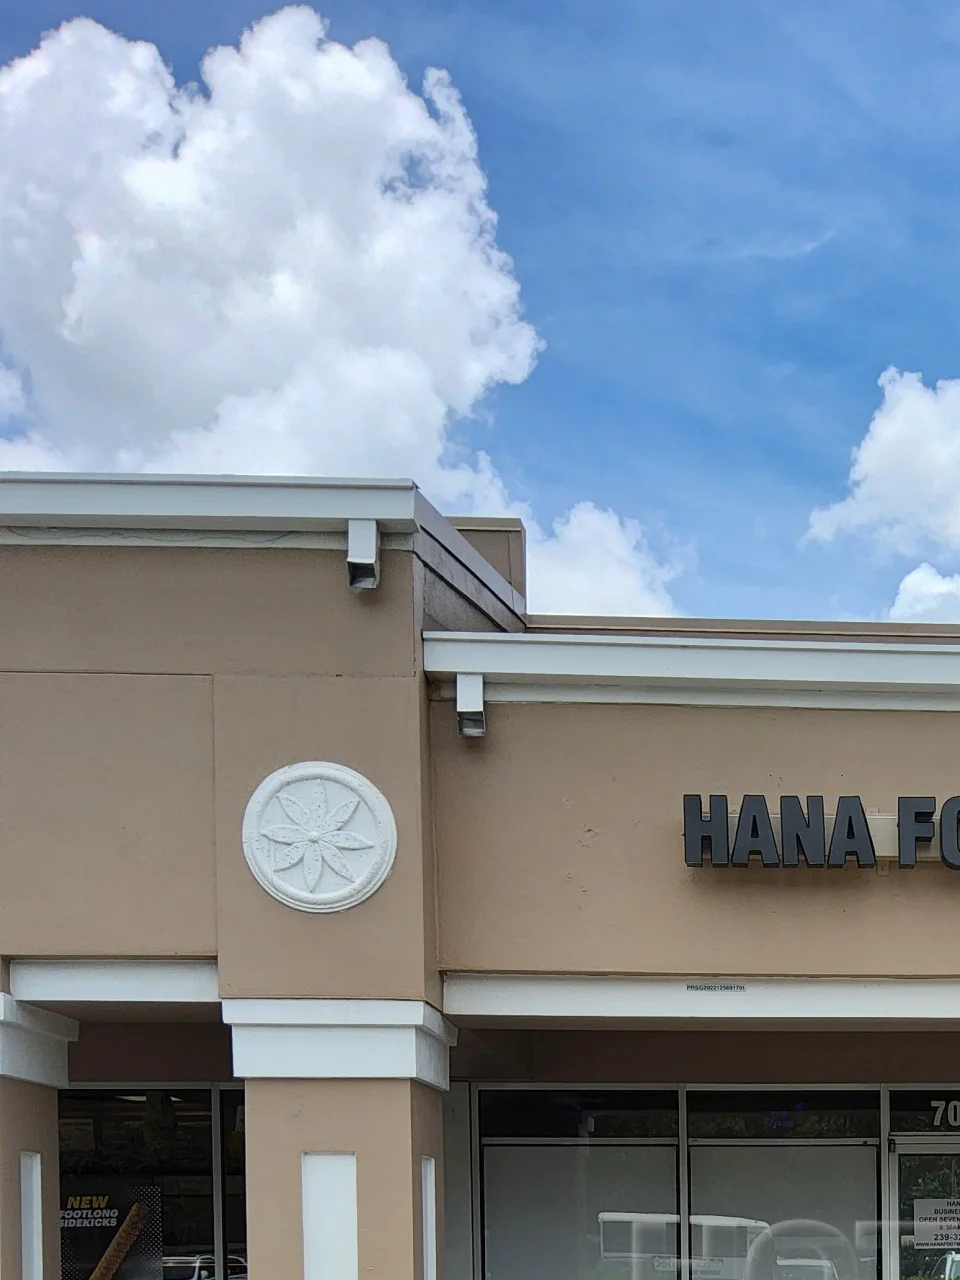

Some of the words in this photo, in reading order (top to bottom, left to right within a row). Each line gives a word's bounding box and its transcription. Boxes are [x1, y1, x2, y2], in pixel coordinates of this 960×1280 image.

[682, 794, 877, 870] HANA
[66, 1195, 110, 1209] NEW
[60, 1209, 119, 1219] FOOTLONG
[59, 1218, 118, 1228] SIDEKICKS
